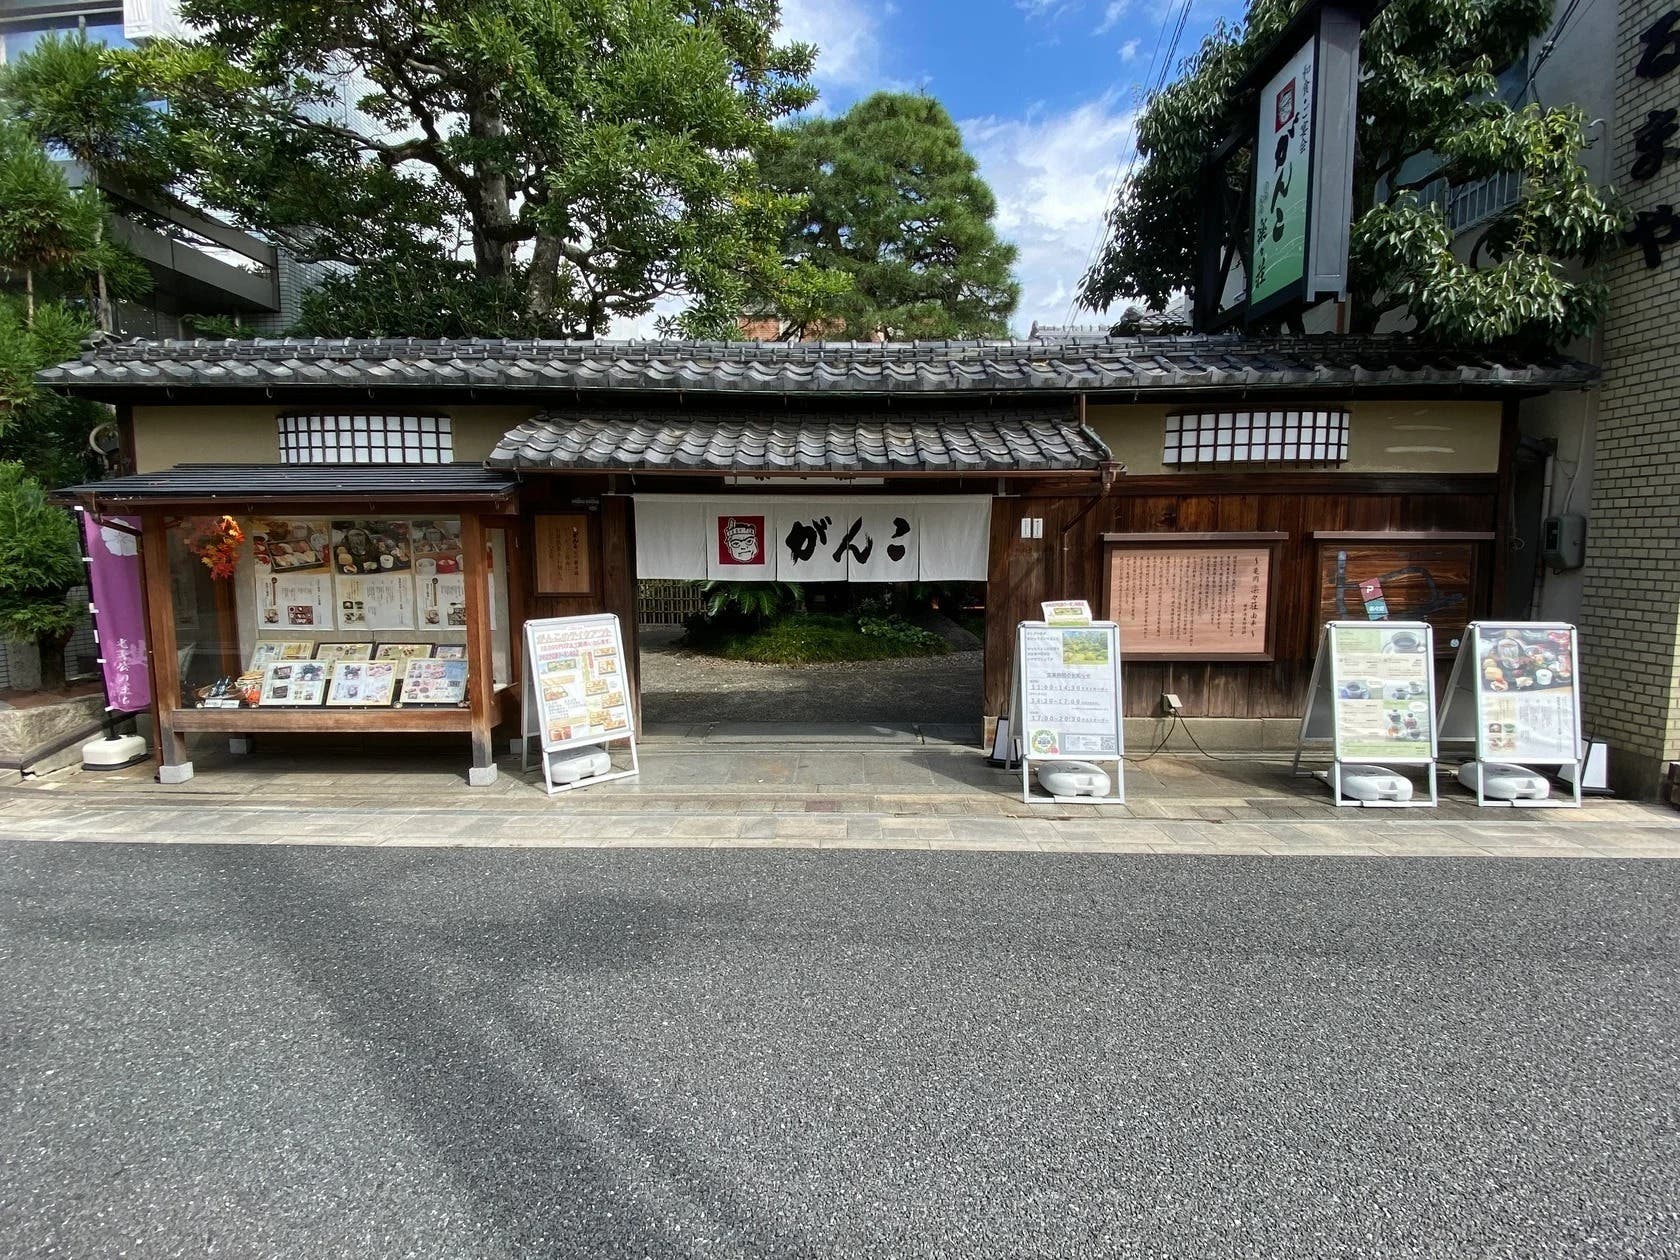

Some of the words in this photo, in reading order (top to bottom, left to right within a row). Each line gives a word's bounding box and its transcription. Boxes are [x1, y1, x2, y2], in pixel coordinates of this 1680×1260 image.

[1270, 111, 1300, 243] がんこ
[785, 515, 911, 566] がんこ
[1366, 585, 1374, 593] P
